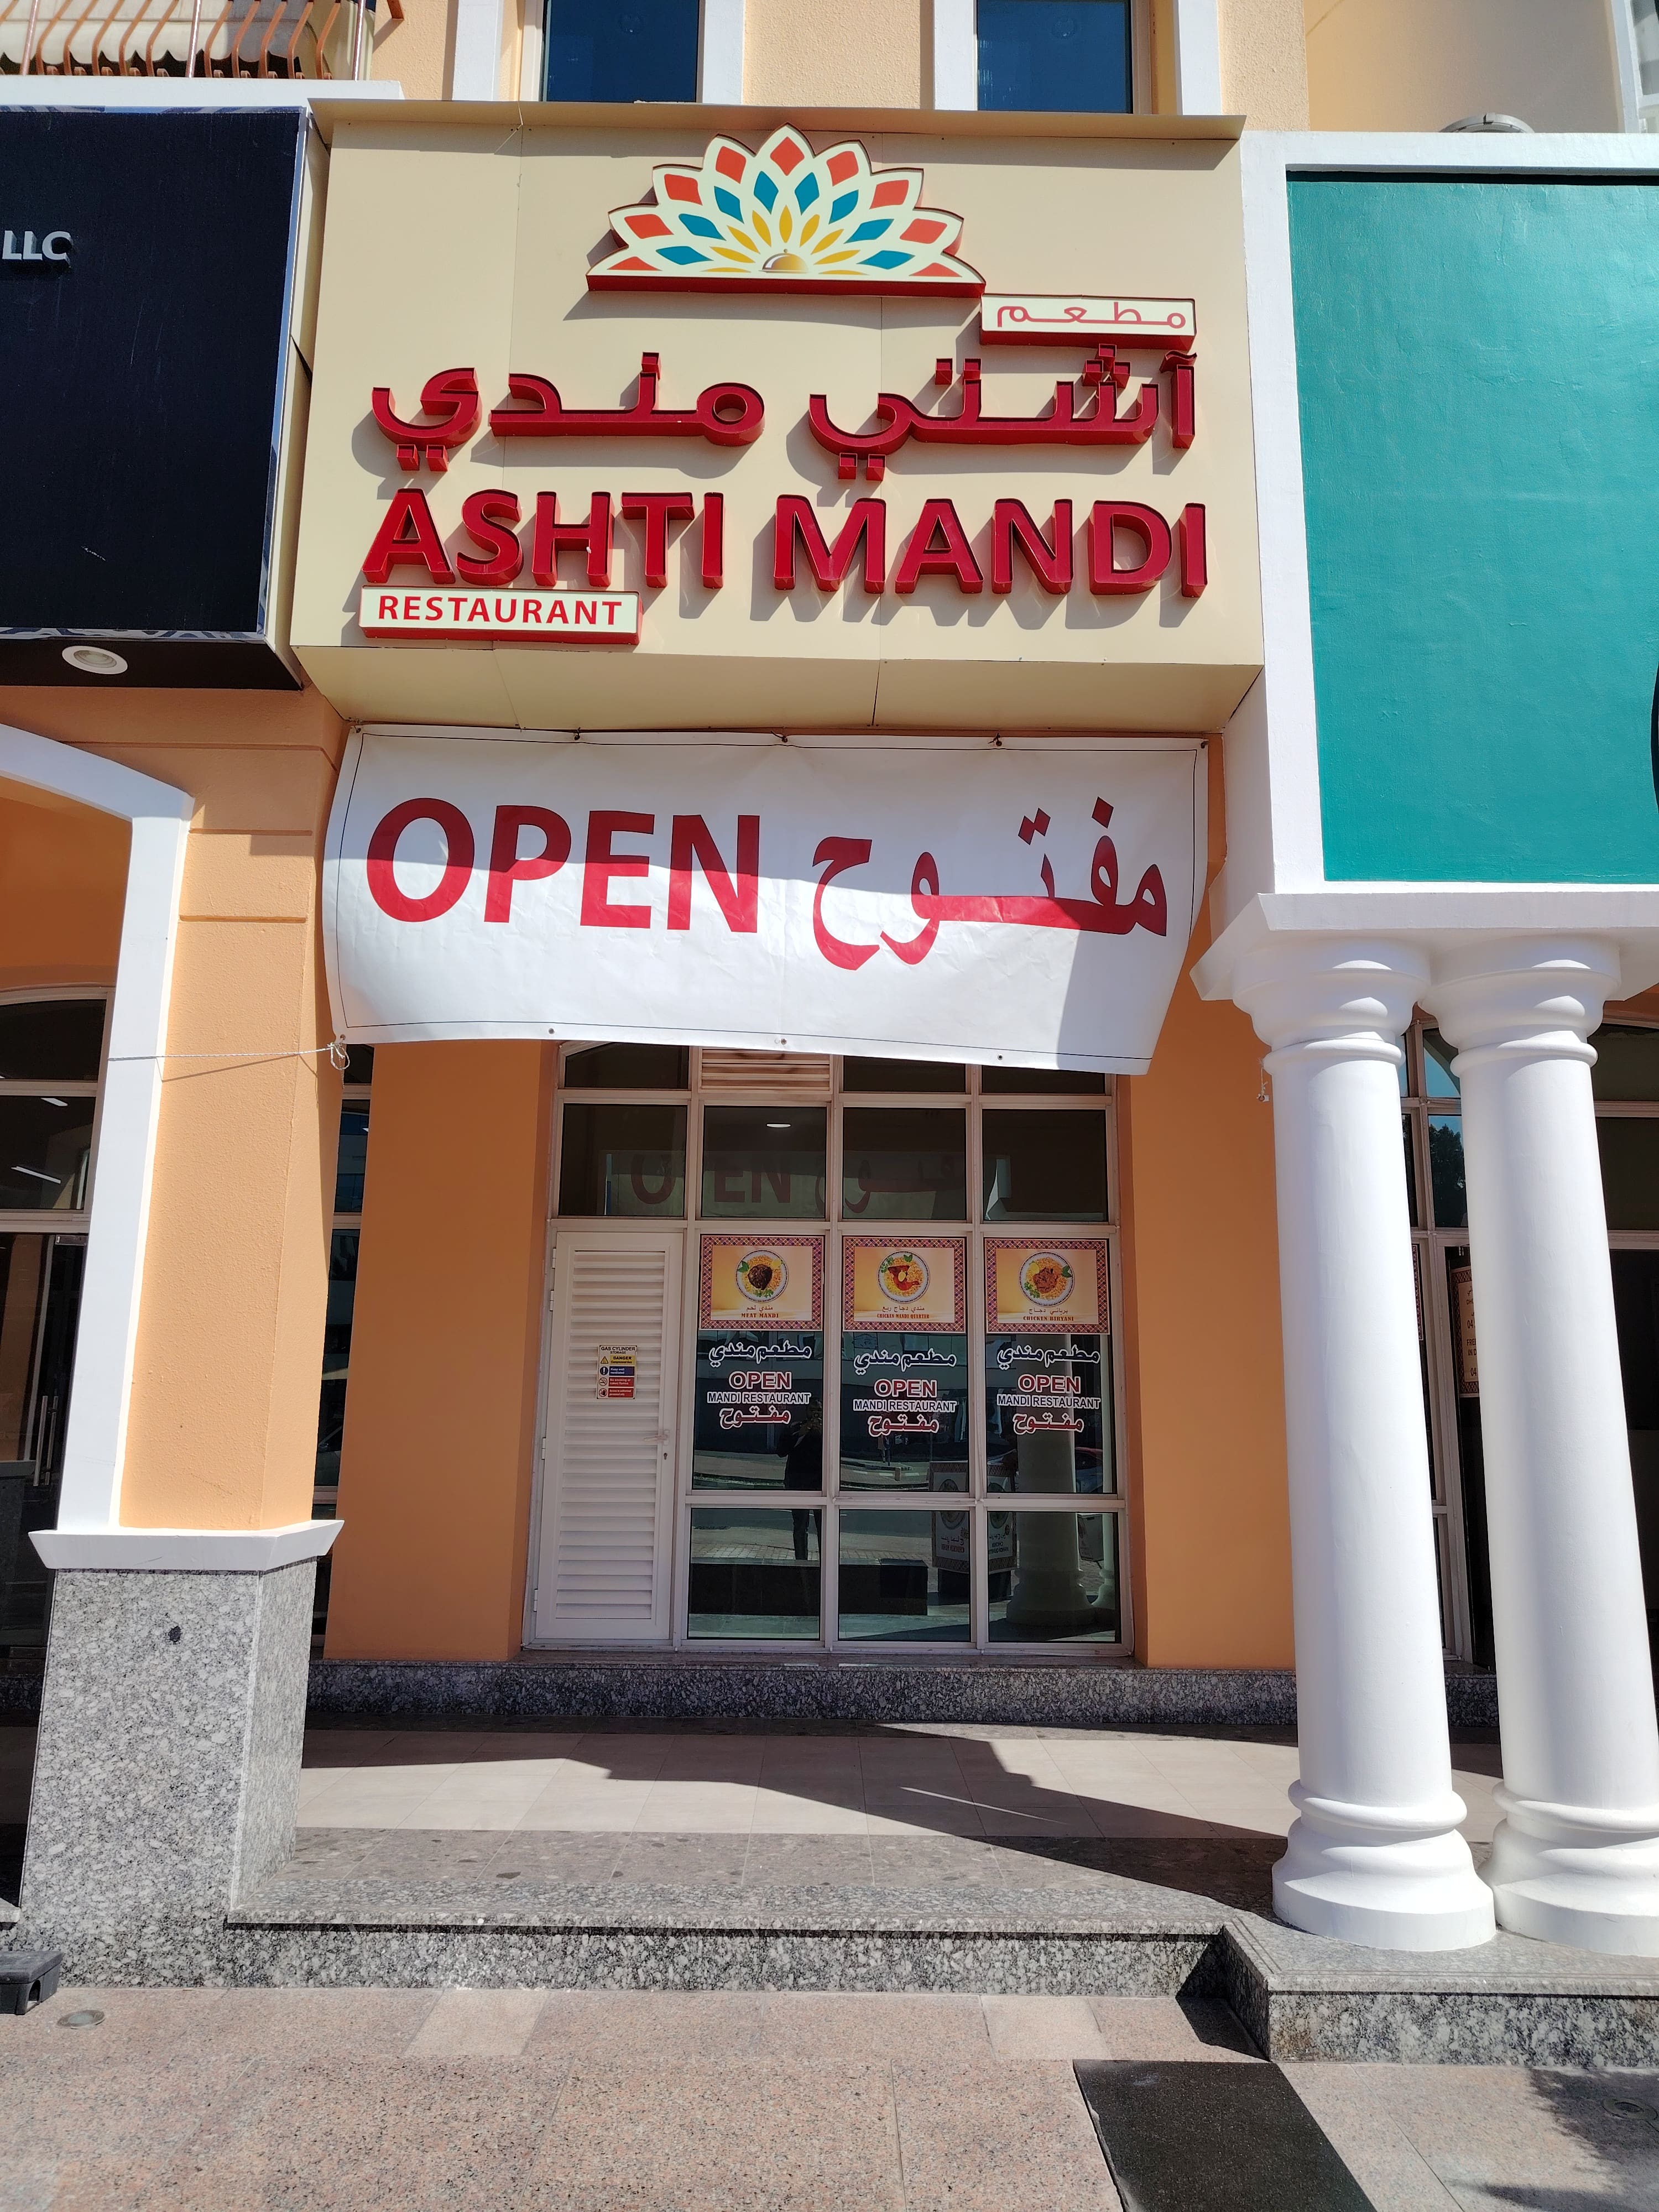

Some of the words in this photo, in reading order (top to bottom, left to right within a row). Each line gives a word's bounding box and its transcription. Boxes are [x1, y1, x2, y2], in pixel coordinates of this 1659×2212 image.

[2, 230, 73, 262] LLC
[997, 301, 1186, 328] مطعم
[372, 352, 765, 472] مندي
[808, 343, 1197, 481] آشتي
[362, 488, 724, 589] ASHTI
[774, 494, 1207, 598] MANDI
[379, 595, 622, 625] RESTAURANT
[367, 797, 759, 933] OPEN
[813, 796, 1167, 969] مفتوح
[709, 1342, 755, 1368] مندي
[757, 1340, 812, 1364] مطعم
[854, 1349, 900, 1375] مندي
[901, 1348, 956, 1371] مطعم
[997, 1345, 1044, 1370] مندي
[1045, 1344, 1100, 1368] مطعم
[729, 1371, 791, 1390] OPEN
[874, 1379, 937, 1397] OPEN
[1018, 1374, 1081, 1394] OPEN
[708, 1392, 741, 1403] MANDI
[743, 1392, 811, 1404] RESTAURANT
[853, 1400, 887, 1411] MANDI
[889, 1400, 957, 1412] RESTAURANT
[997, 1394, 1030, 1406] MANDI
[1032, 1395, 1100, 1409] RESTAURANT
[719, 1406, 791, 1429] مفتوح
[868, 1414, 939, 1437] مفتوح
[1013, 1412, 1084, 1435] مفتوح
